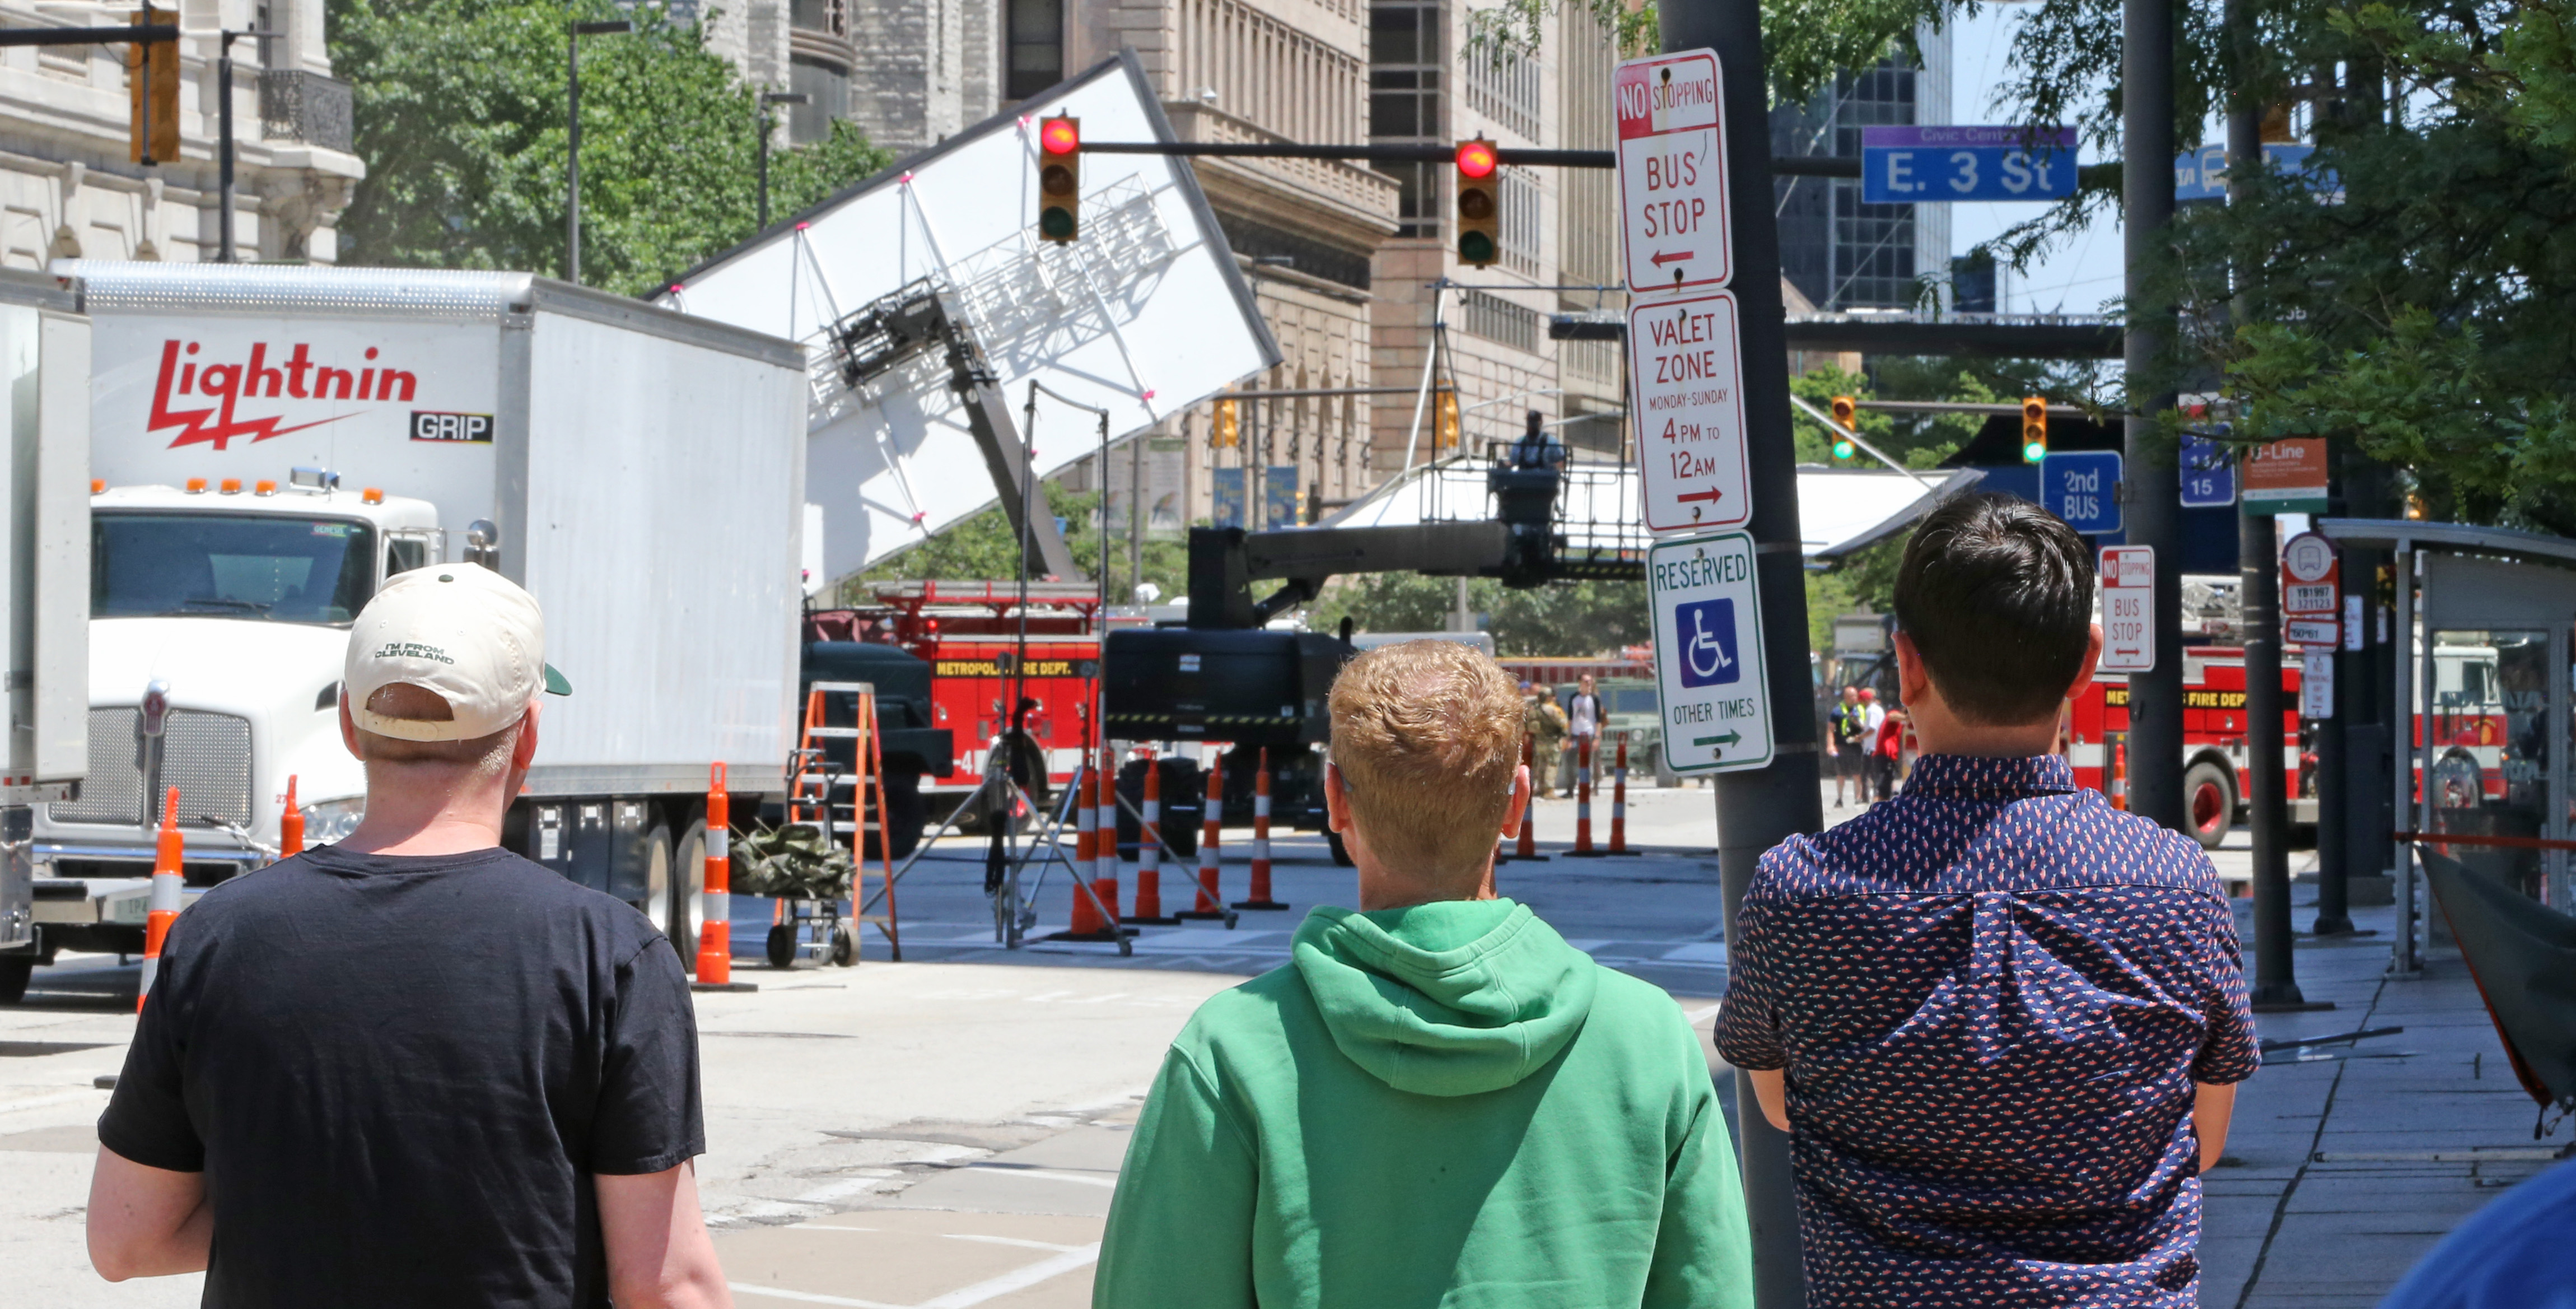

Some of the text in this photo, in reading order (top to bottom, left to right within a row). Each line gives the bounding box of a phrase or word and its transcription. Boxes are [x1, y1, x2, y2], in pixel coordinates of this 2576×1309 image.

[1620, 78, 1712, 120] NO STOPPING
[1920, 128, 1959, 142] Civic
[1646, 152, 1696, 191] BUS
[1888, 151, 2052, 193] E. 3 St
[1644, 198, 1705, 237] STOP
[1650, 313, 1715, 347] VALET
[1656, 351, 1716, 384] ZONE
[147, 339, 417, 450] Lightnin
[1650, 388, 1728, 411] MONDAY-SUNDAY
[417, 414, 486, 438] GRIP
[1663, 417, 1719, 444] 4 PM TO
[2064, 468, 2099, 492] 2nd
[2191, 479, 2213, 496] 15
[2064, 496, 2099, 520] BUS
[1656, 554, 1747, 591] RESERVED
[2104, 560, 2150, 579] NO STOPPING
[2115, 599, 2139, 616] BUS
[2298, 599, 2331, 609] 321123
[2112, 623, 2143, 641] STOP
[375, 650, 455, 665] CLEVELAND
[404, 643, 445, 655] FROM
[1040, 662, 1072, 675] DEPT.
[1674, 698, 1754, 725] OTHER TIMES
[2188, 693, 2218, 706] FIRE
[2220, 693, 2246, 707] DEP
